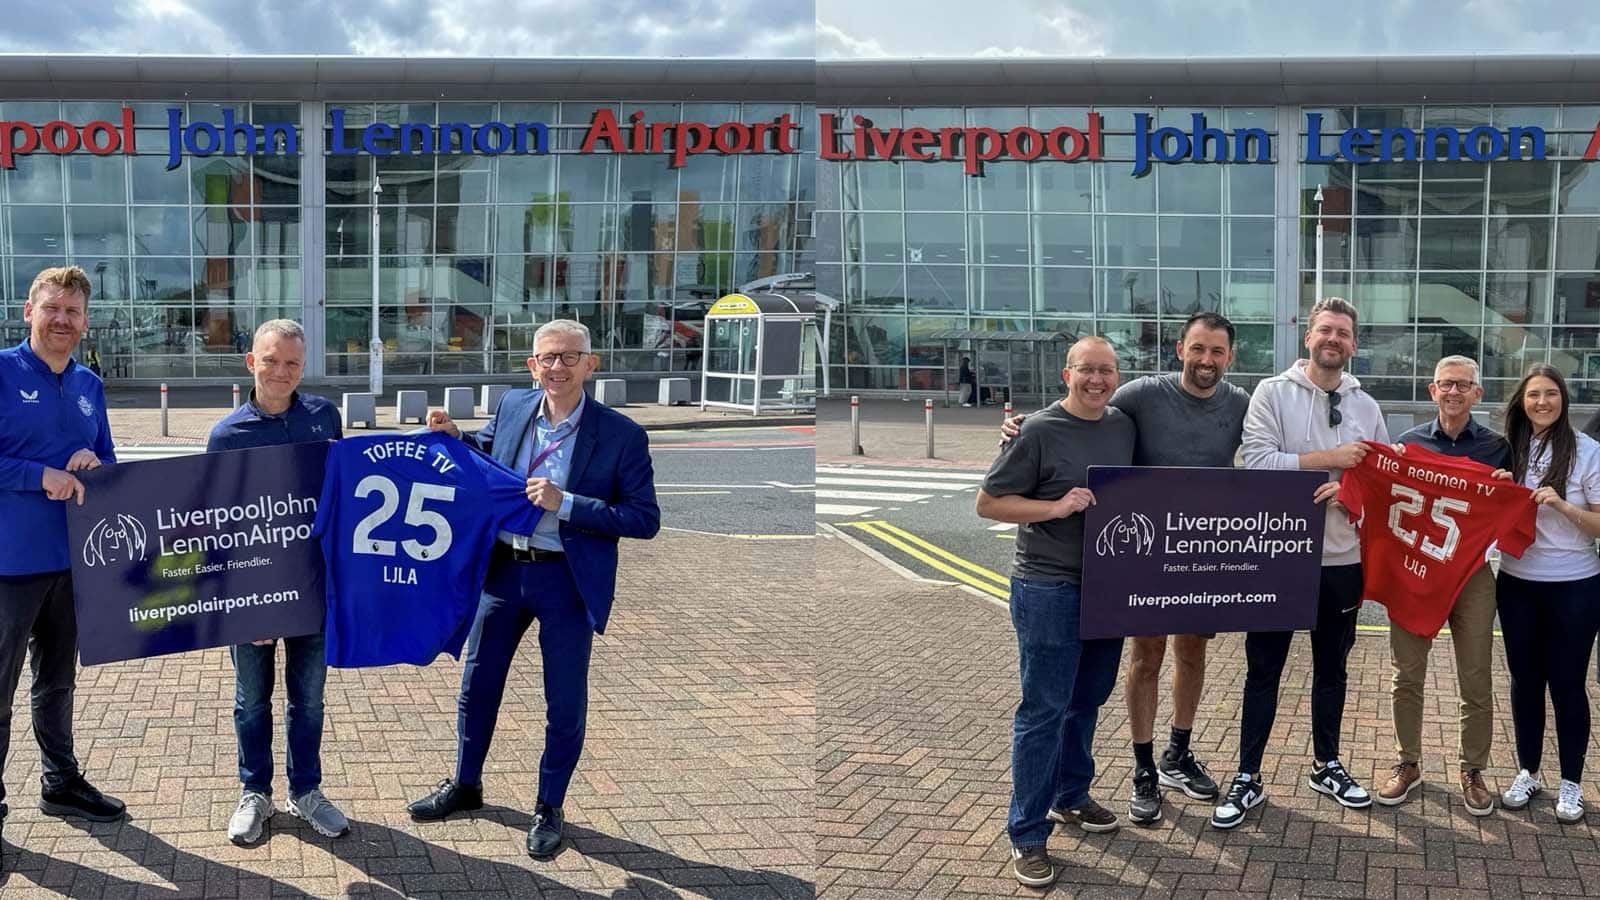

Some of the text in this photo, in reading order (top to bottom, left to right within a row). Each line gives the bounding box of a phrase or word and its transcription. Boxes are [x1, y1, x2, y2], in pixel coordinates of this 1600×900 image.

[166, 108, 297, 171] John
[330, 108, 549, 156] Lennon
[579, 108, 797, 169] Airport
[818, 112, 1101, 177] Liverpool
[1132, 112, 1272, 178] John
[1306, 112, 1546, 162] Lennon
[363, 441, 455, 474] TOFFEE TV
[1476, 483, 1496, 497] TV
[353, 474, 456, 562] 25
[1387, 482, 1471, 564] 25
[159, 523, 315, 557] LennonAirpo
[162, 555, 273, 578] Faster. Easier. Friendlier.
[383, 565, 418, 585] LJLA
[1163, 562, 1260, 573] Faster. Easier. Friendlier.
[1403, 554, 1428, 580] LJLA
[129, 588, 299, 623] liverpoolairport.com
[1128, 591, 1277, 609] liverpoolairport.com
